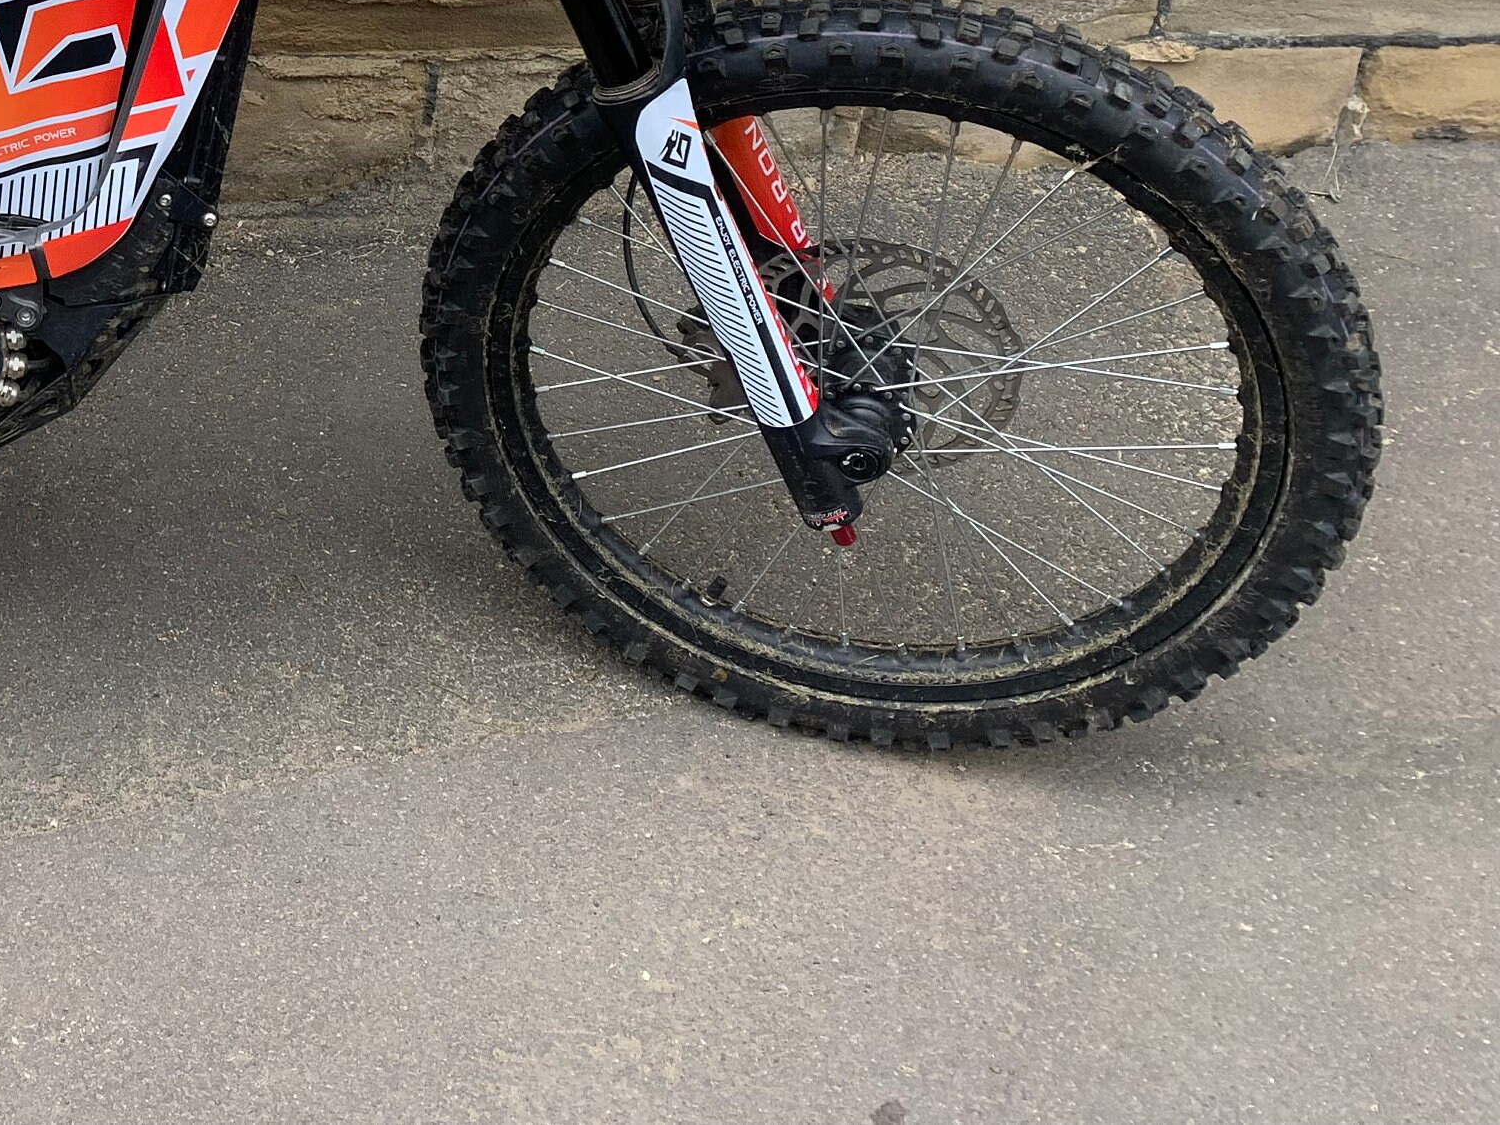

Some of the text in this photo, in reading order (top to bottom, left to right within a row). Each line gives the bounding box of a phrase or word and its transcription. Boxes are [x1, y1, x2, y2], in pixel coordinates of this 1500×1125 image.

[34, 127, 77, 144] POWER
[715, 215, 763, 325] ENJOY ELECTRIC POWER
